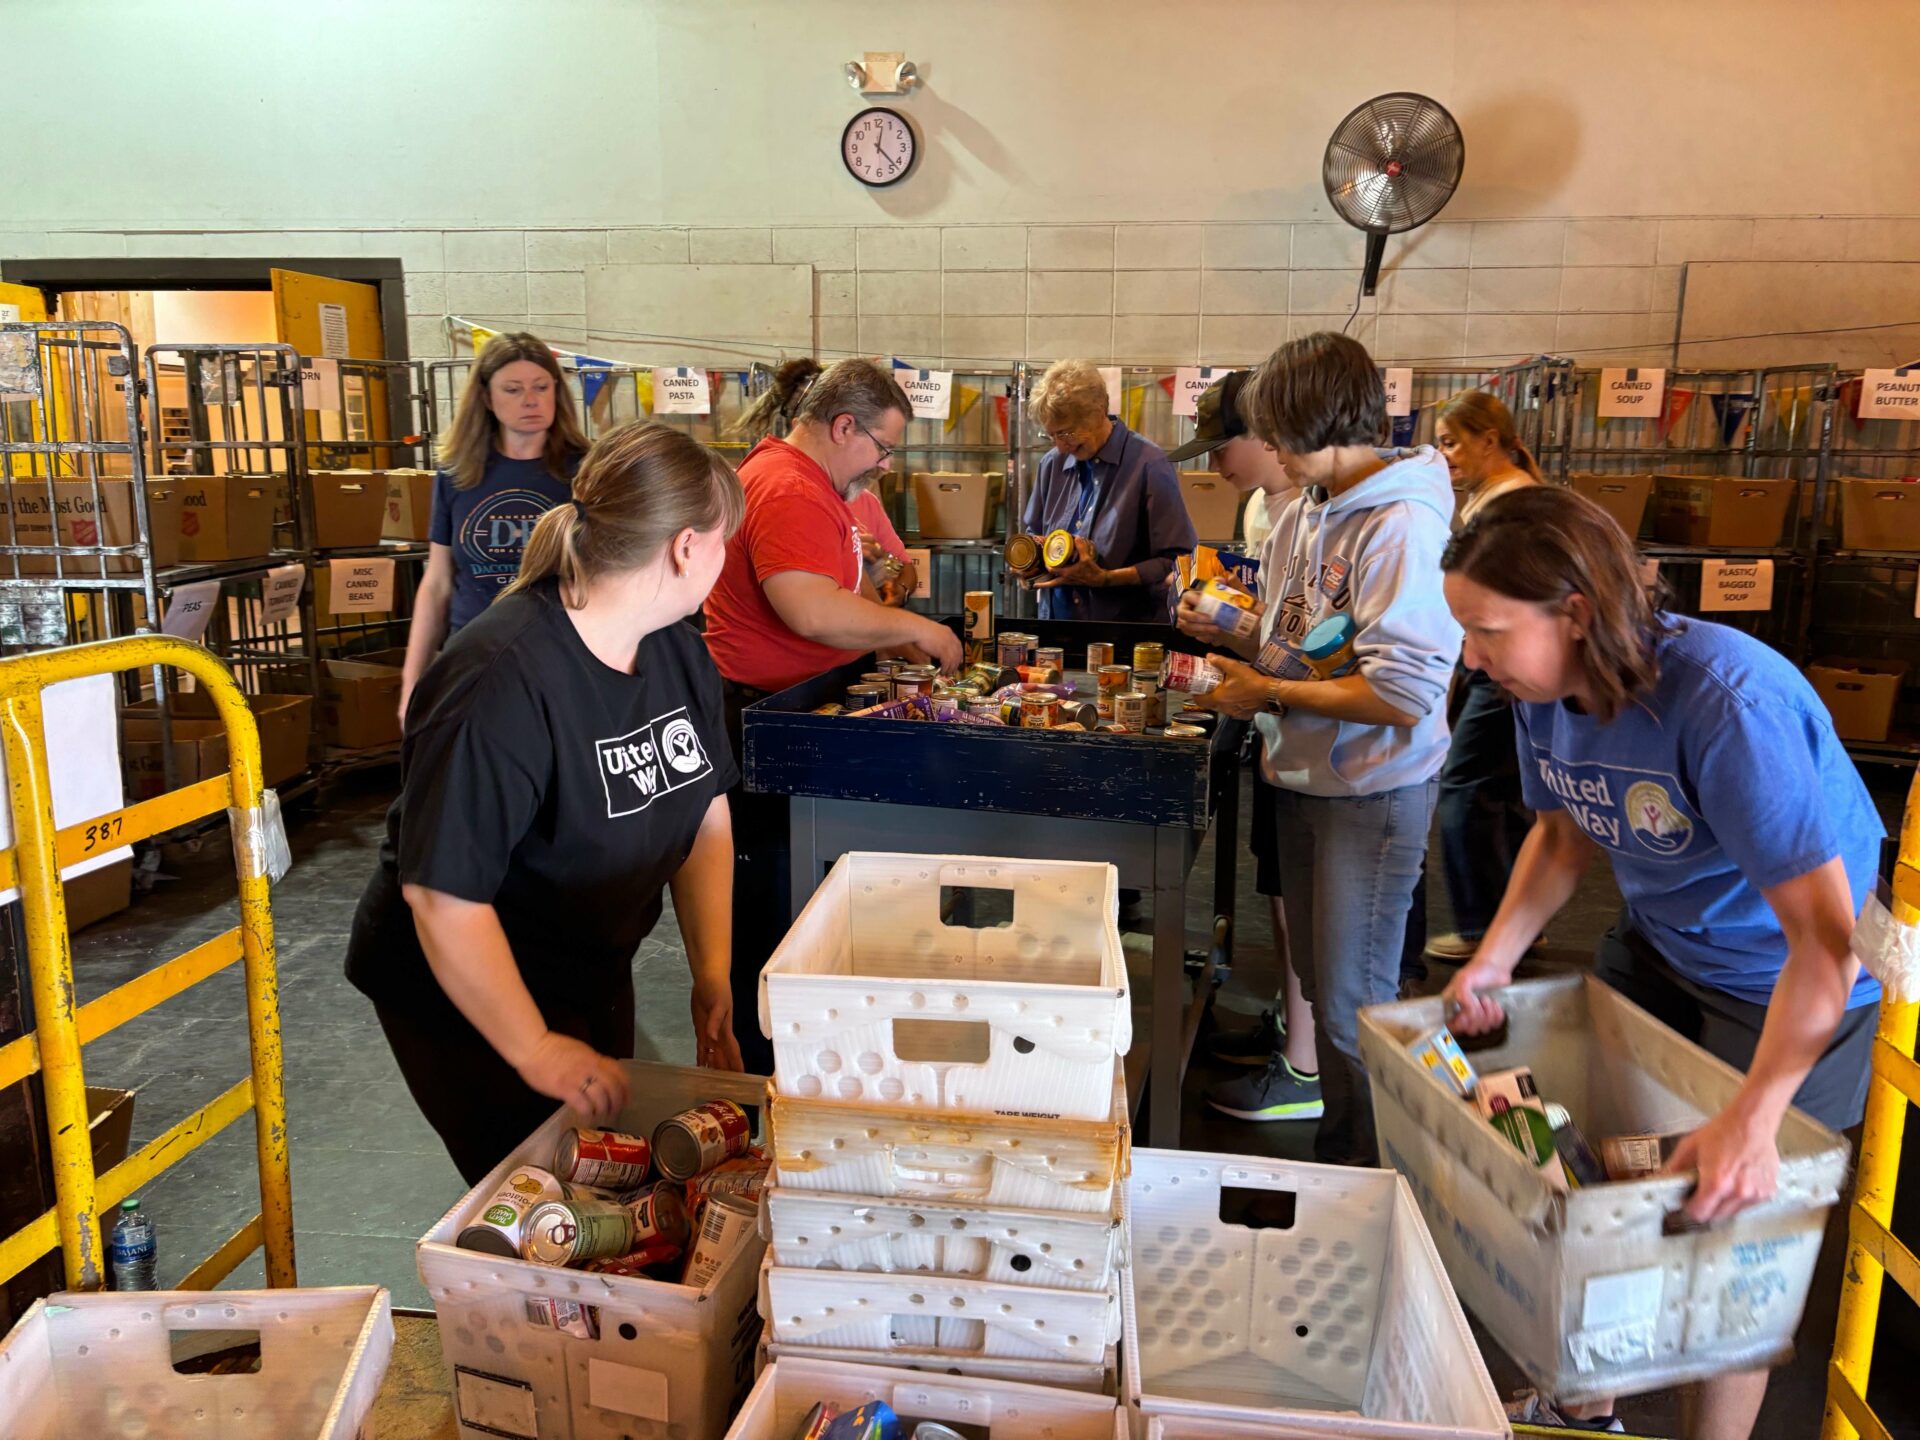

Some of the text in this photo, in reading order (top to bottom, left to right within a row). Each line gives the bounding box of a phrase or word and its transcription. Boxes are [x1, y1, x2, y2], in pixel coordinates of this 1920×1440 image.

[300, 371, 320, 381] ORN
[663, 379, 699, 387] CANNED
[904, 381, 941, 391] CANNED
[1185, 381, 1212, 389] CANN
[1611, 381, 1652, 390] CANNED
[1876, 383, 1920, 392] PEANUT
[669, 392, 695, 400] PASTA
[910, 394, 934, 403] MEAT
[1616, 395, 1643, 403] SOUP
[1875, 396, 1919, 406] BUTTER
[17, 496, 39, 513] the
[353, 567, 373, 576] MISC
[346, 580, 378, 588] CANNED
[1718, 581, 1756, 589] BAGGED
[348, 592, 375, 600] BEANS
[1723, 593, 1749, 601] SOUP
[182, 600, 202, 613] PEAS
[84, 817, 122, 852] 387
